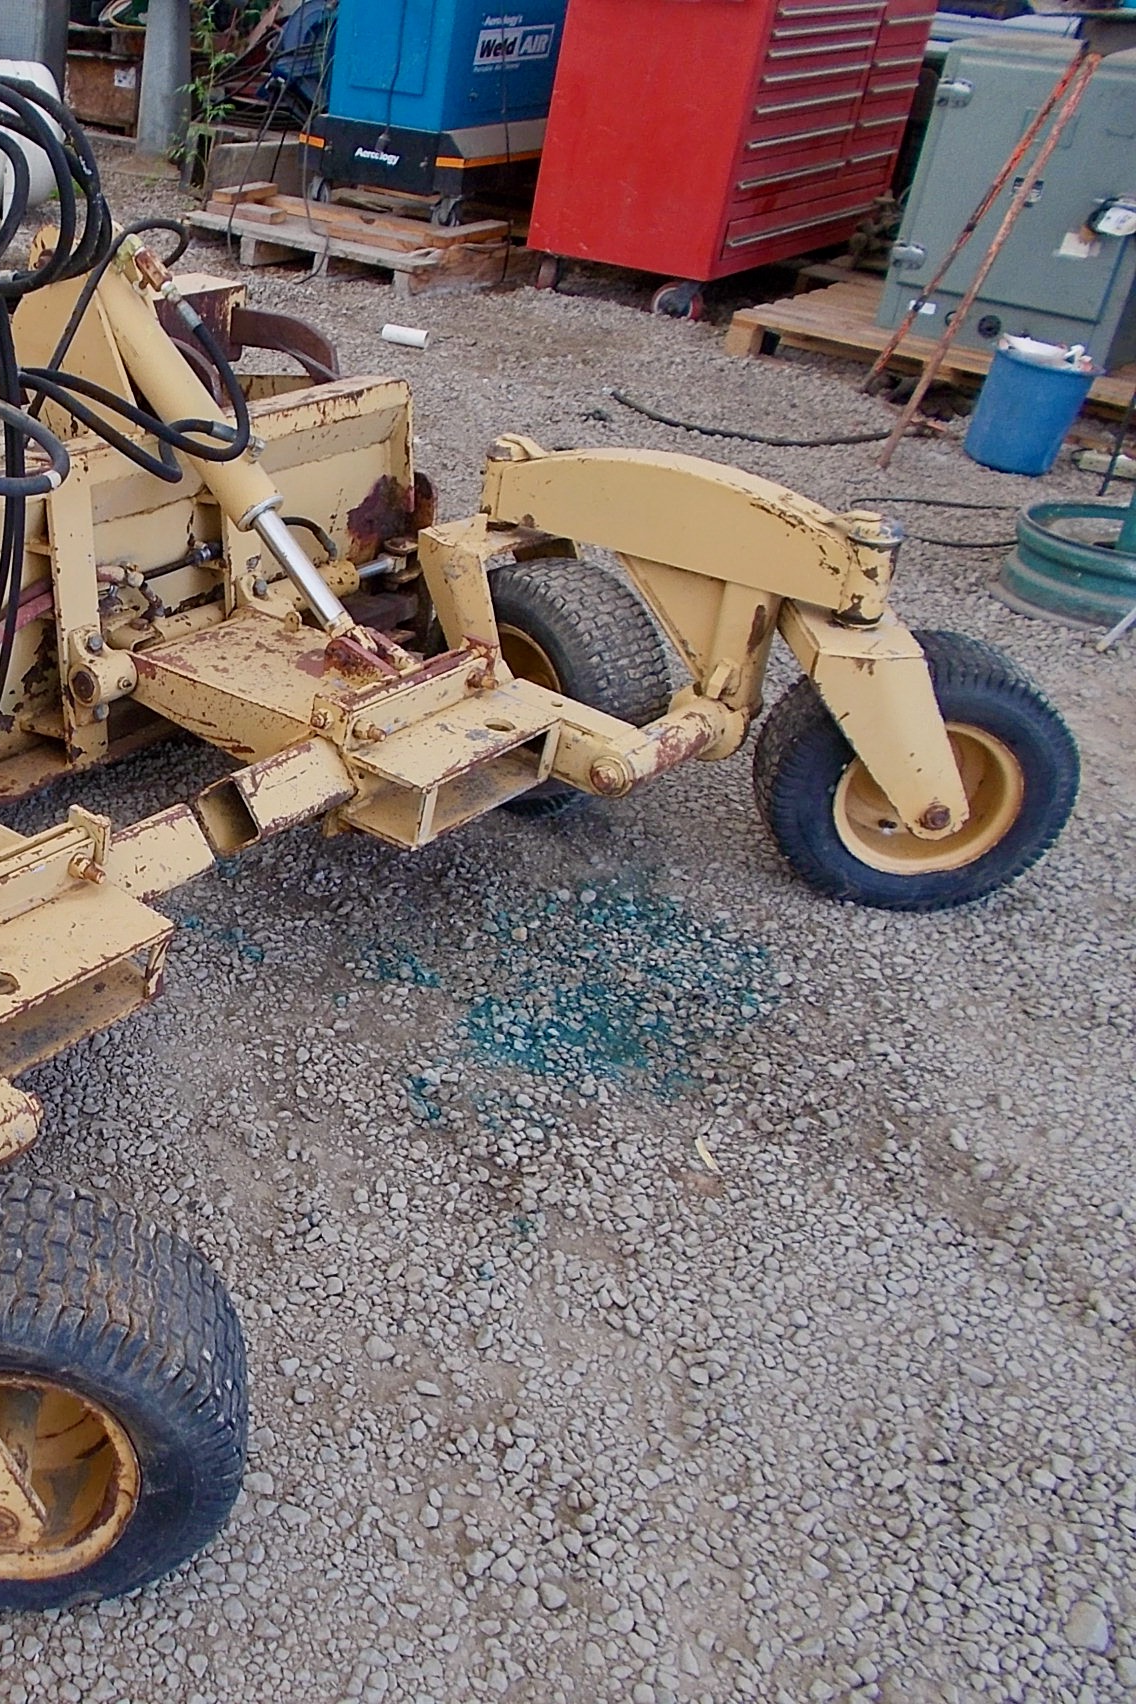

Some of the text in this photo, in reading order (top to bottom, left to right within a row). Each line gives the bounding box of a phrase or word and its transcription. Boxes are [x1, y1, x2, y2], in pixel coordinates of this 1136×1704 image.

[479, 34, 549, 58] Weld AIR
[354, 147, 400, 166] Aerology
